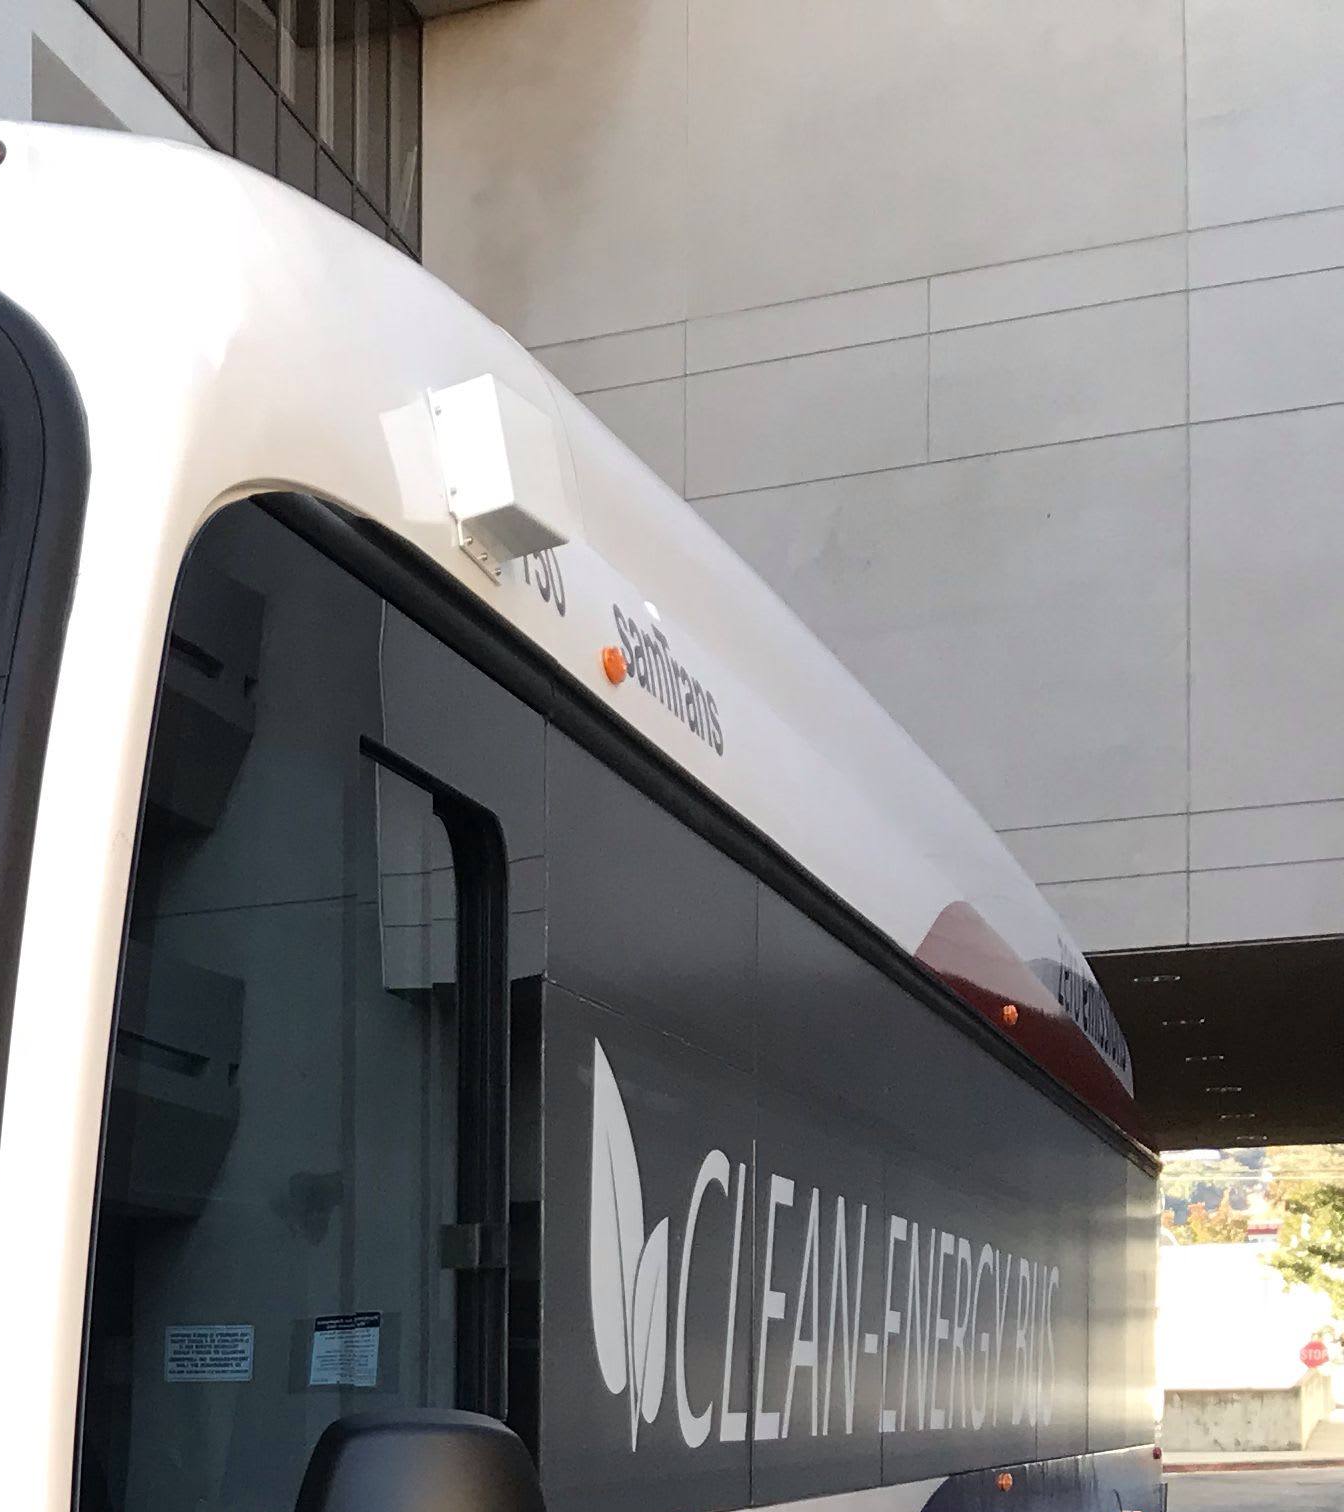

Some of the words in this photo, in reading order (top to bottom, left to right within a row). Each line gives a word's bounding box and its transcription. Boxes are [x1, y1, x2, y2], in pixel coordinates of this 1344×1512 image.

[675, 1149, 1012, 1449] CLEAN-ENERGY
[1012, 1257, 1060, 1427] BUS
[1301, 1348, 1328, 1361] STOP
